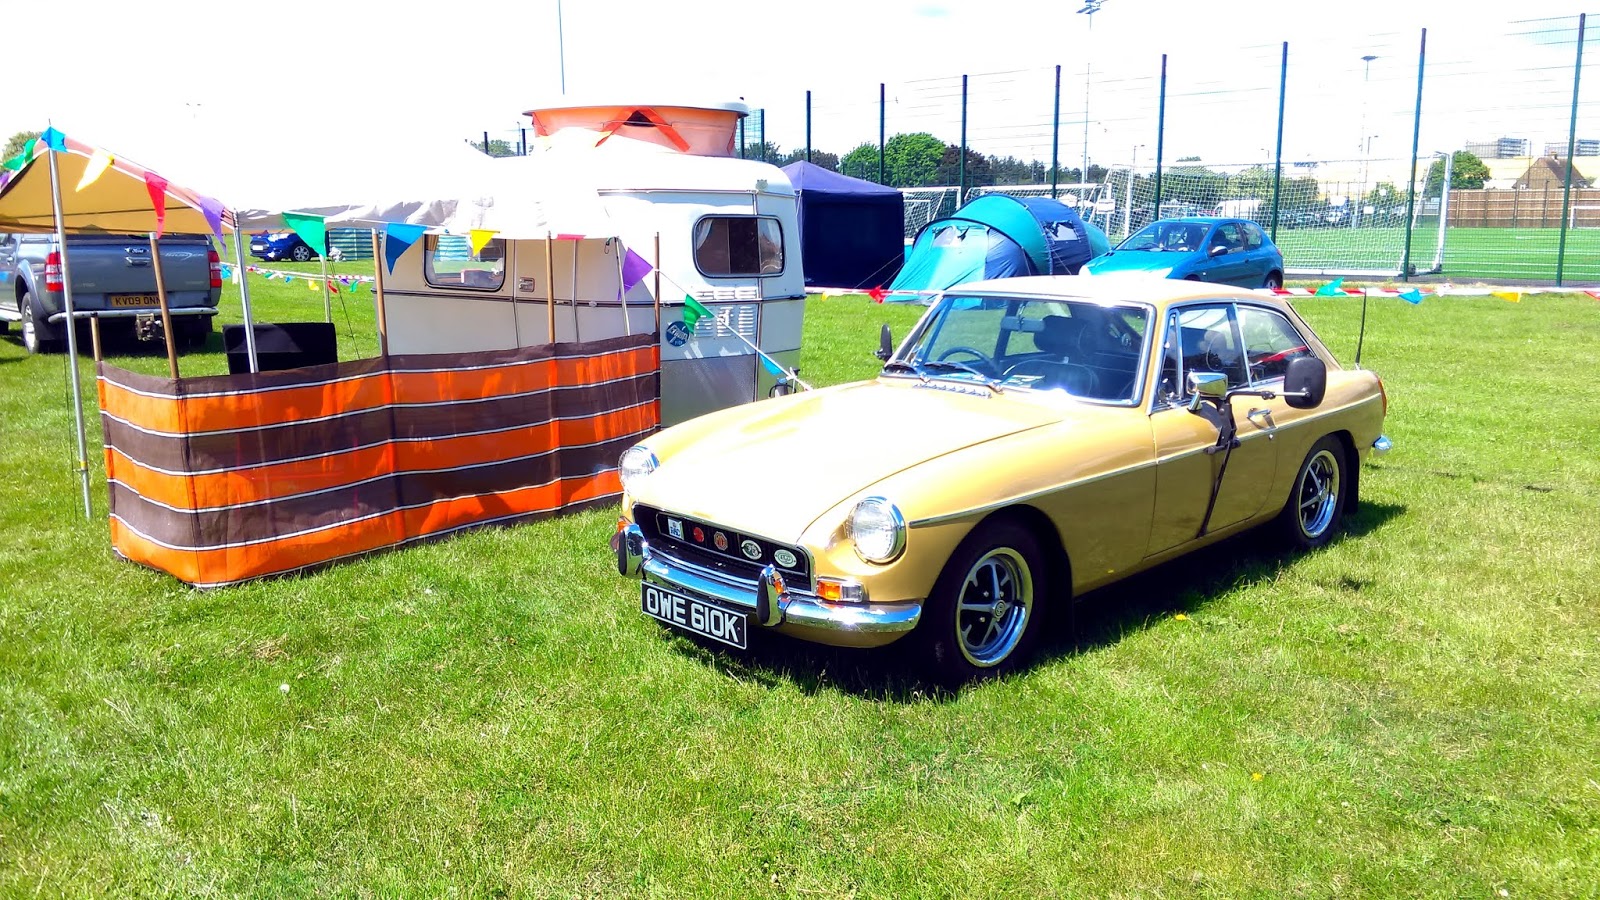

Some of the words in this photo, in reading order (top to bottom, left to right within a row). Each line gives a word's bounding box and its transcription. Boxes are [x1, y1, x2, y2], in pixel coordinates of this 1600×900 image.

[115, 296, 141, 306] KV09
[646, 587, 687, 625] OWE
[690, 602, 739, 643] 610K
